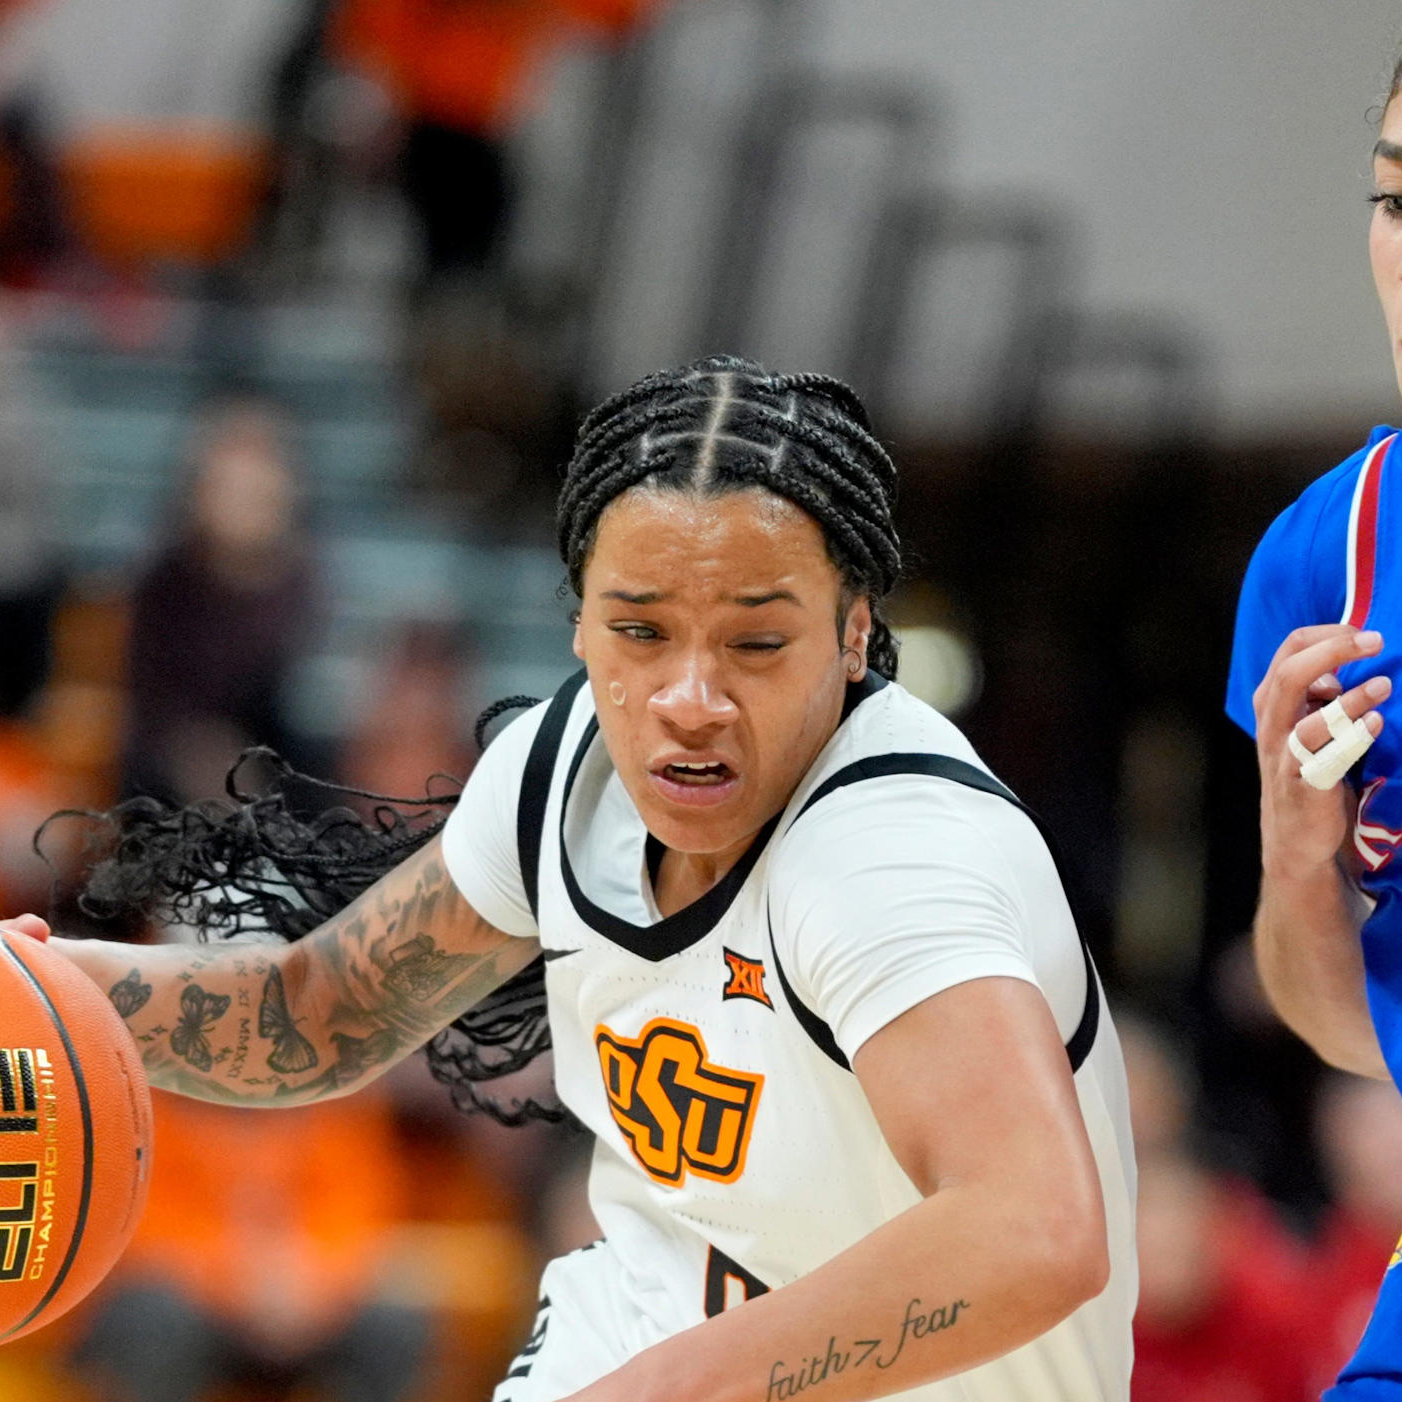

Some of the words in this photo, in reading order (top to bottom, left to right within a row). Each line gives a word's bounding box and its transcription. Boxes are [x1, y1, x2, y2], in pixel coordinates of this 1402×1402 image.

[722, 946, 775, 1012] XII
[594, 1016, 765, 1189] OSU
[875, 1298, 970, 1369] fear
